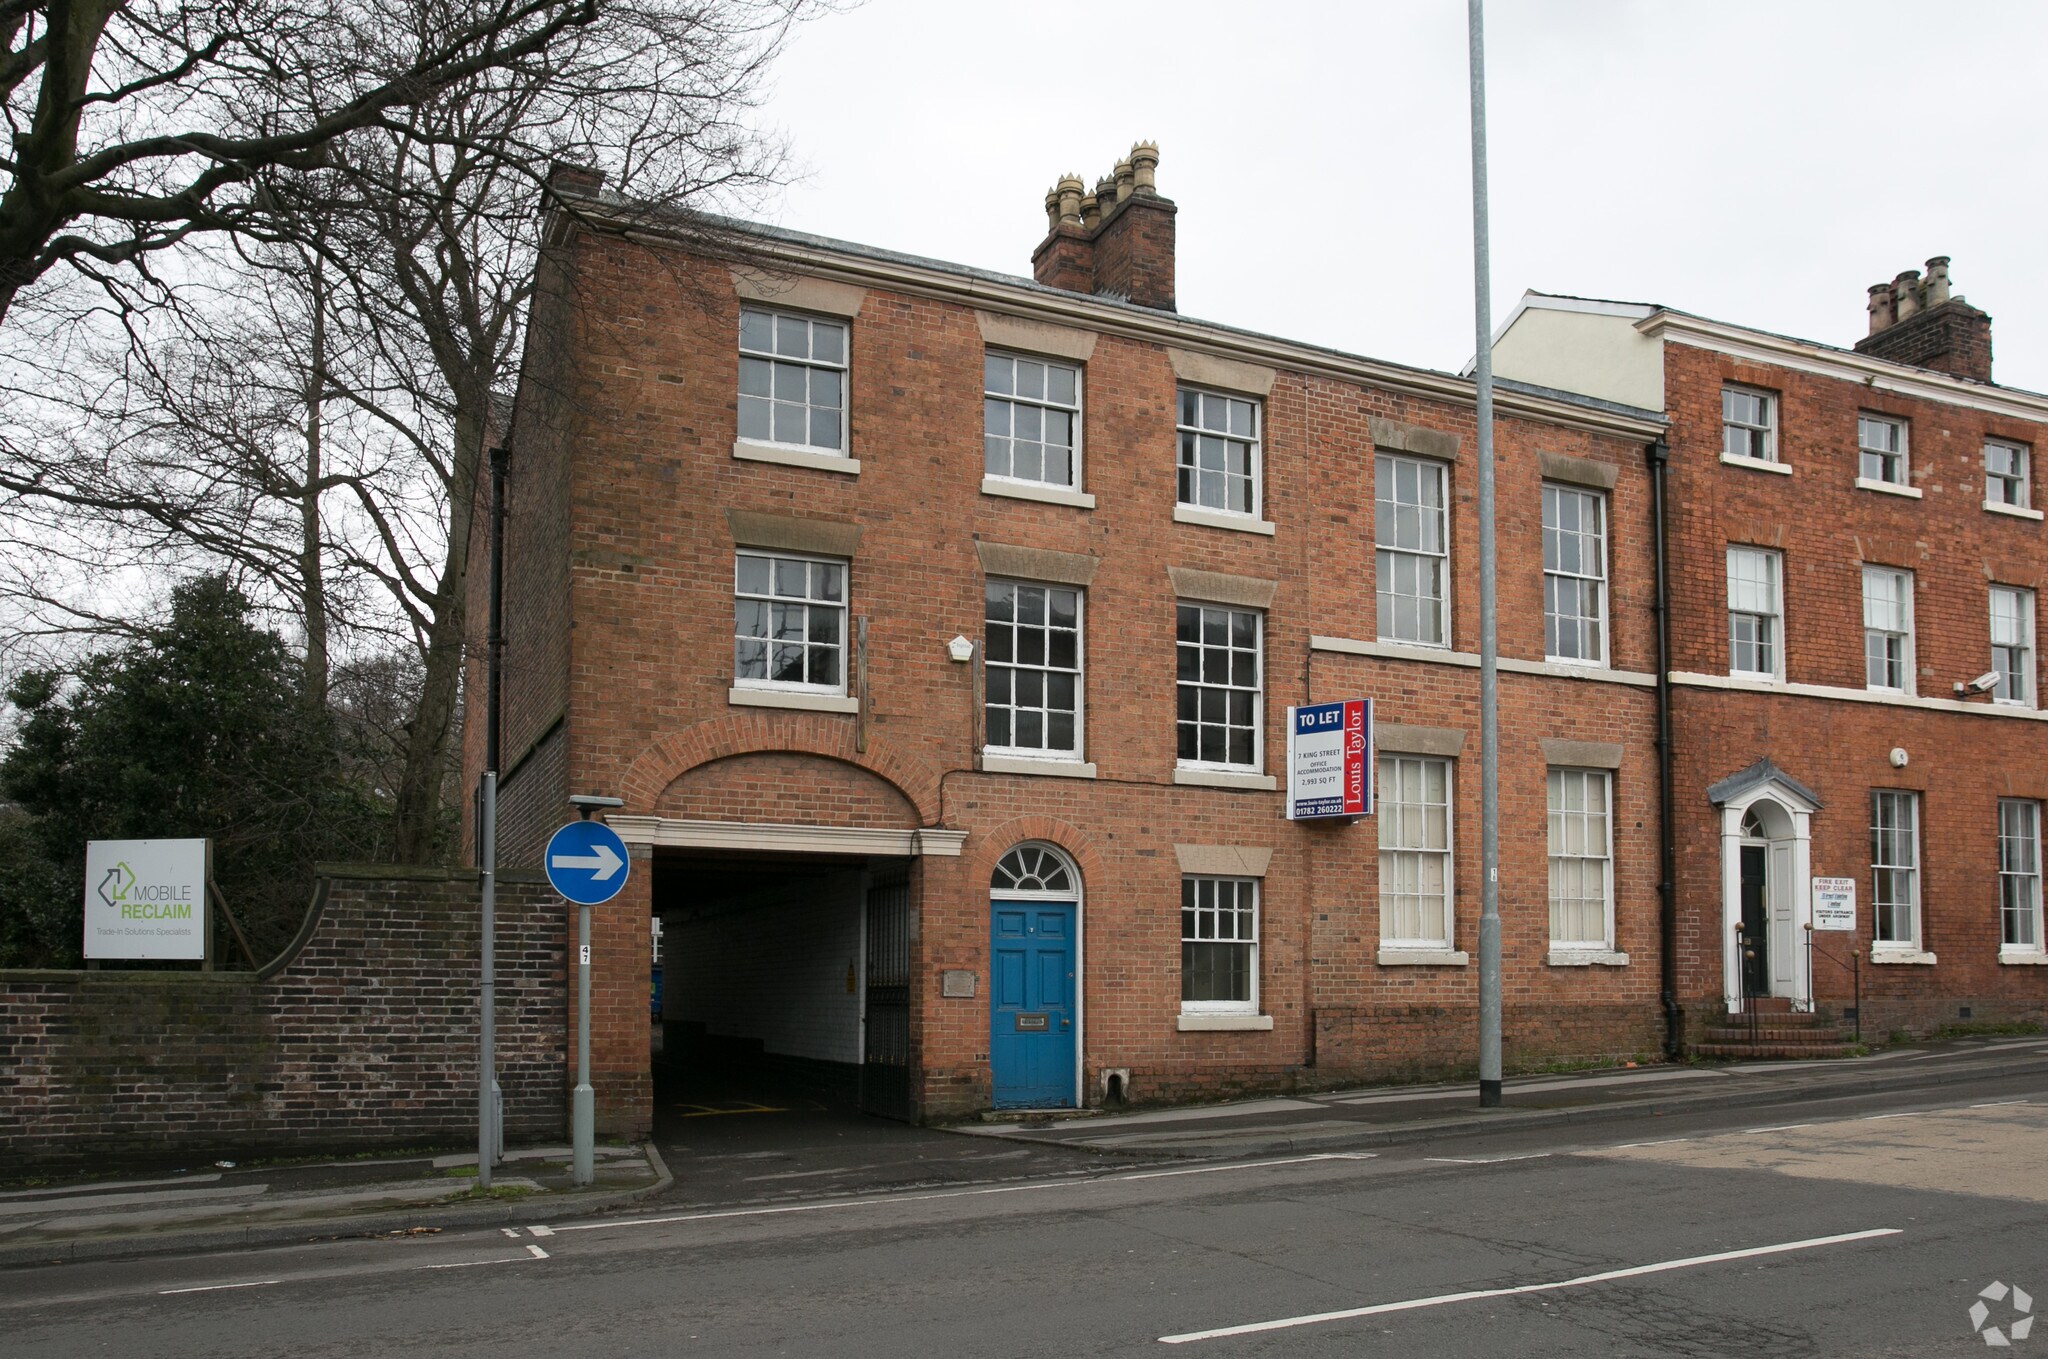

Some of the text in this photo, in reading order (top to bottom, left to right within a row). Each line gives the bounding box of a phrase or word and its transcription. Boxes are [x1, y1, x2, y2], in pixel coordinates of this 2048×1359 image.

[1300, 711, 1340, 727] TO LET
[1319, 749, 1341, 758] STREET
[1346, 710, 1366, 805] Louis Taylor
[1297, 766, 1342, 775] ACCOMMODATION
[1296, 804, 1342, 816] 01782 260222
[134, 885, 191, 901] MOBILE
[121, 904, 191, 919] RECLAIM
[97, 927, 191, 937] Trade-In Solutions Specialists
